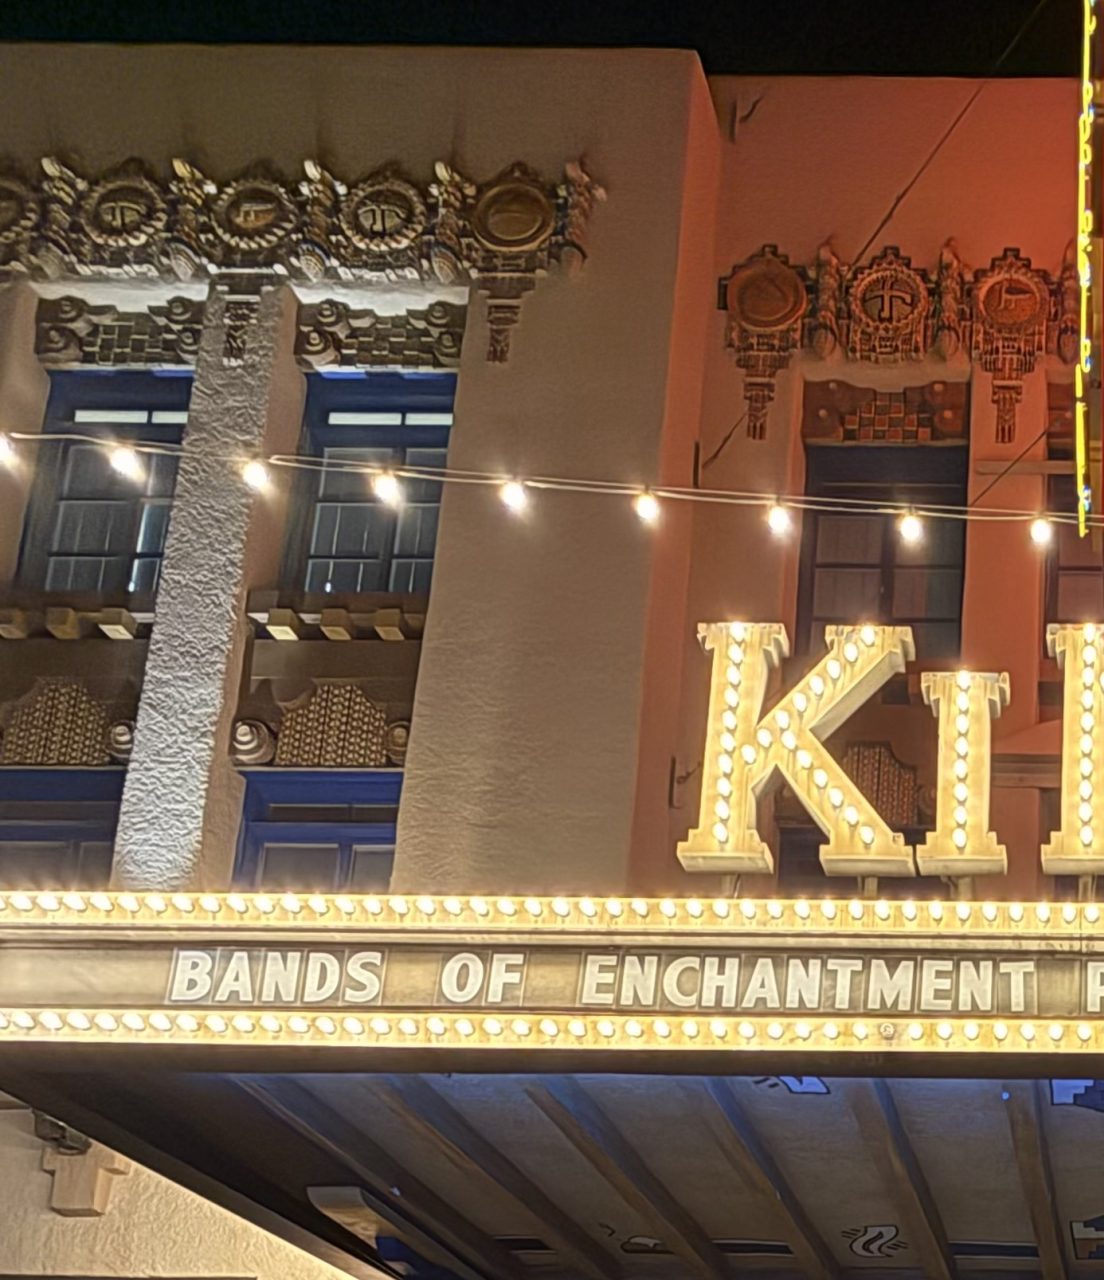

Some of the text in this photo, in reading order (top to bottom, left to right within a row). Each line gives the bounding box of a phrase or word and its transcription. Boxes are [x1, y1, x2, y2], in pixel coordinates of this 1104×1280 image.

[169, 950, 384, 1005] BANDS
[440, 952, 526, 1004] OF
[580, 953, 1037, 1013] ENCHANTMENT
